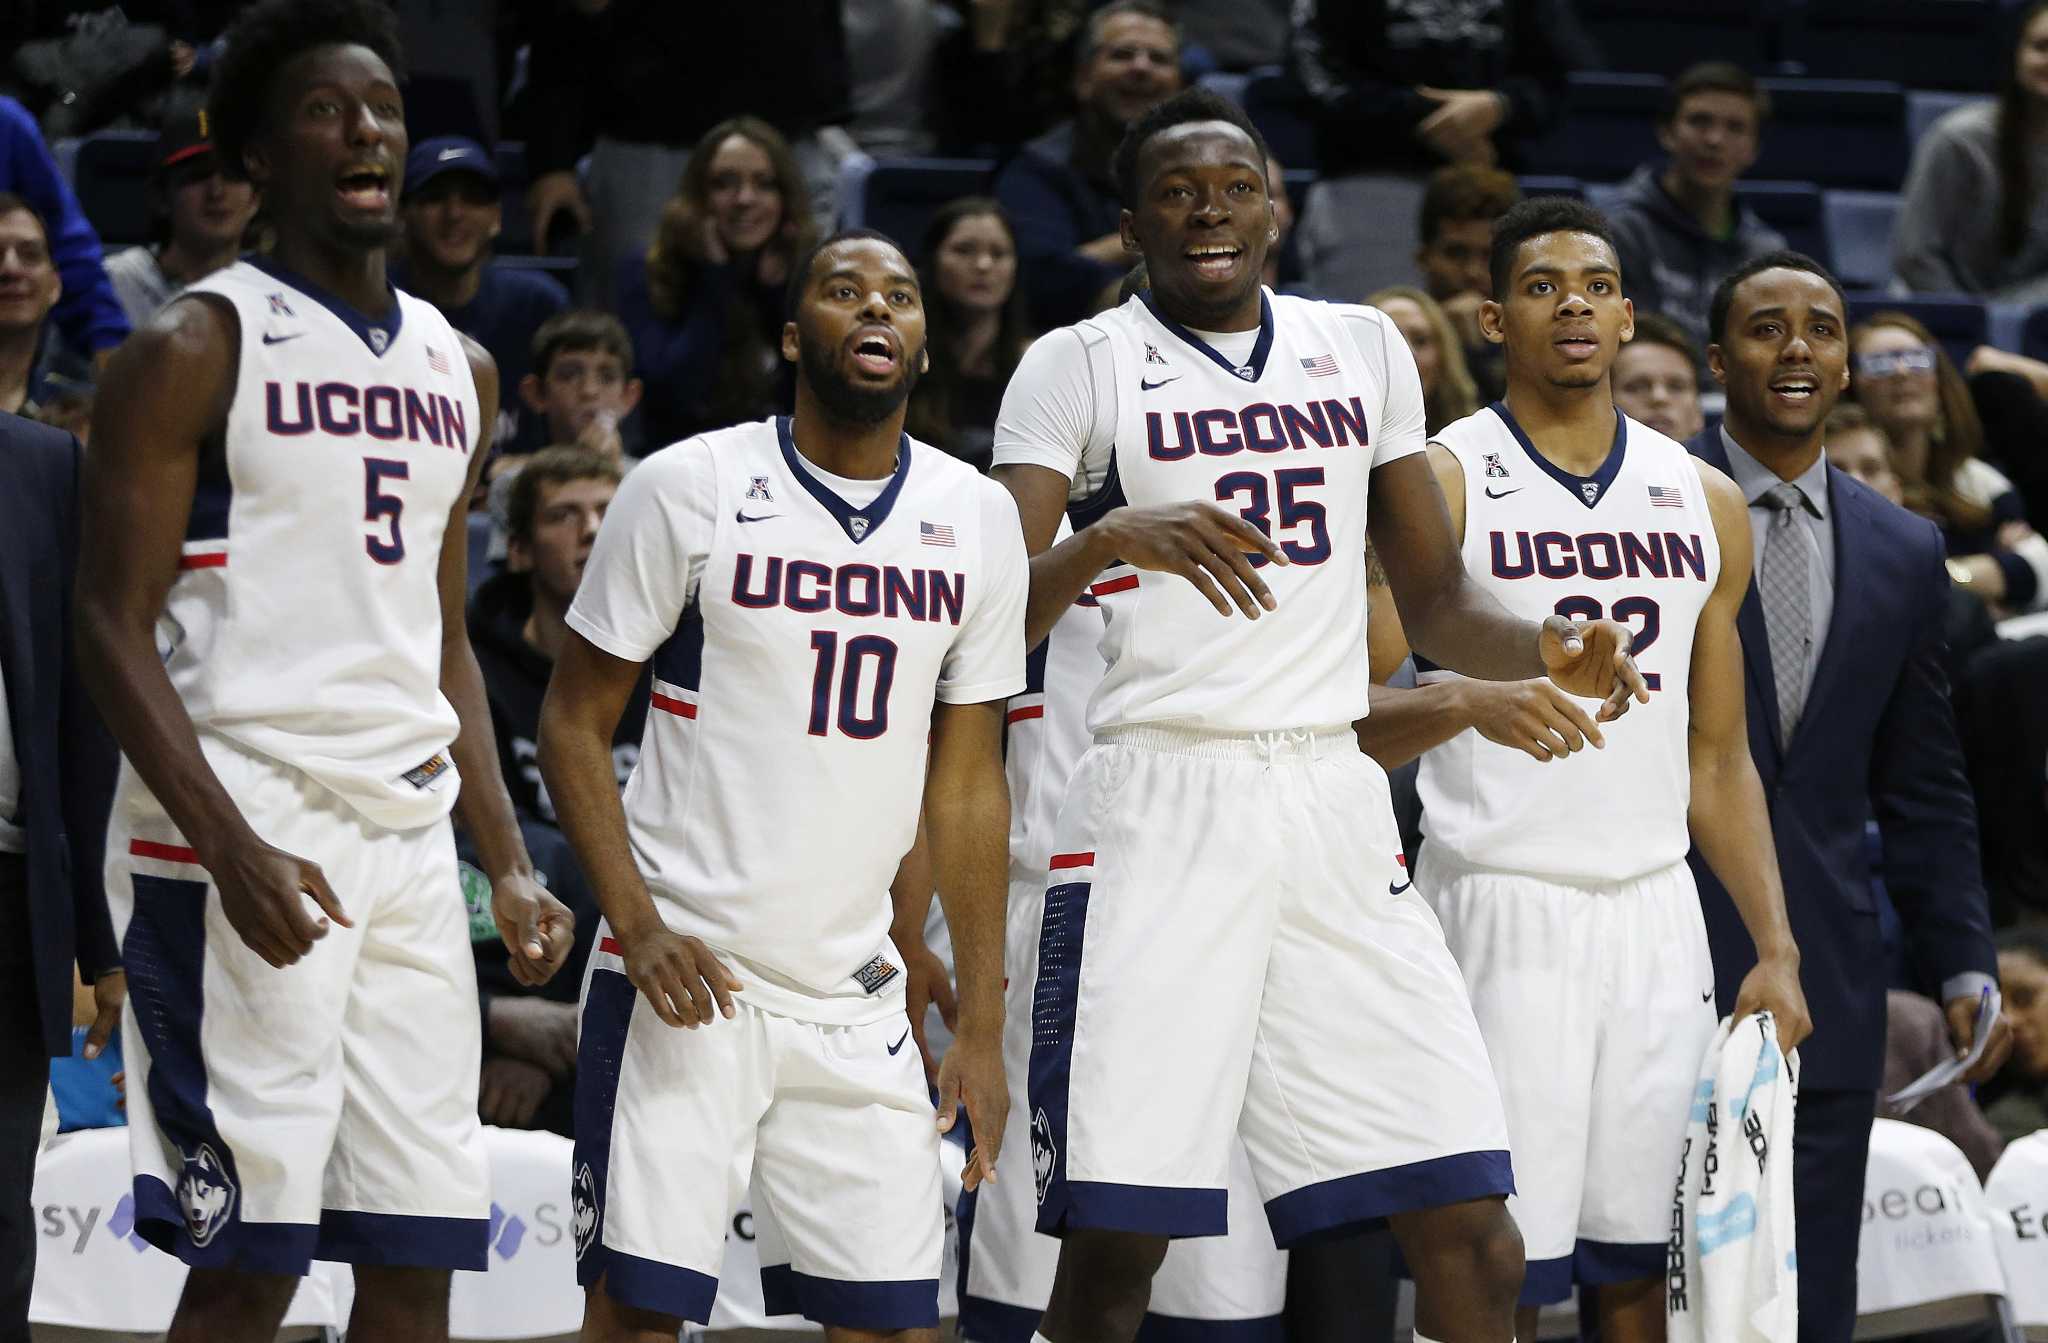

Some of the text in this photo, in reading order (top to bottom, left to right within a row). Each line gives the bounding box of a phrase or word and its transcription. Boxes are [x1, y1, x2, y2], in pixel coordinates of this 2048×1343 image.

[265, 381, 468, 454] UCONN
[1145, 396, 1369, 461] UCONN
[362, 457, 410, 565] 5
[1214, 466, 1332, 569] 35
[731, 553, 965, 625] UCONN
[1489, 531, 1706, 582] UCONN
[808, 630, 898, 740] 10
[1554, 595, 1661, 691] 2
